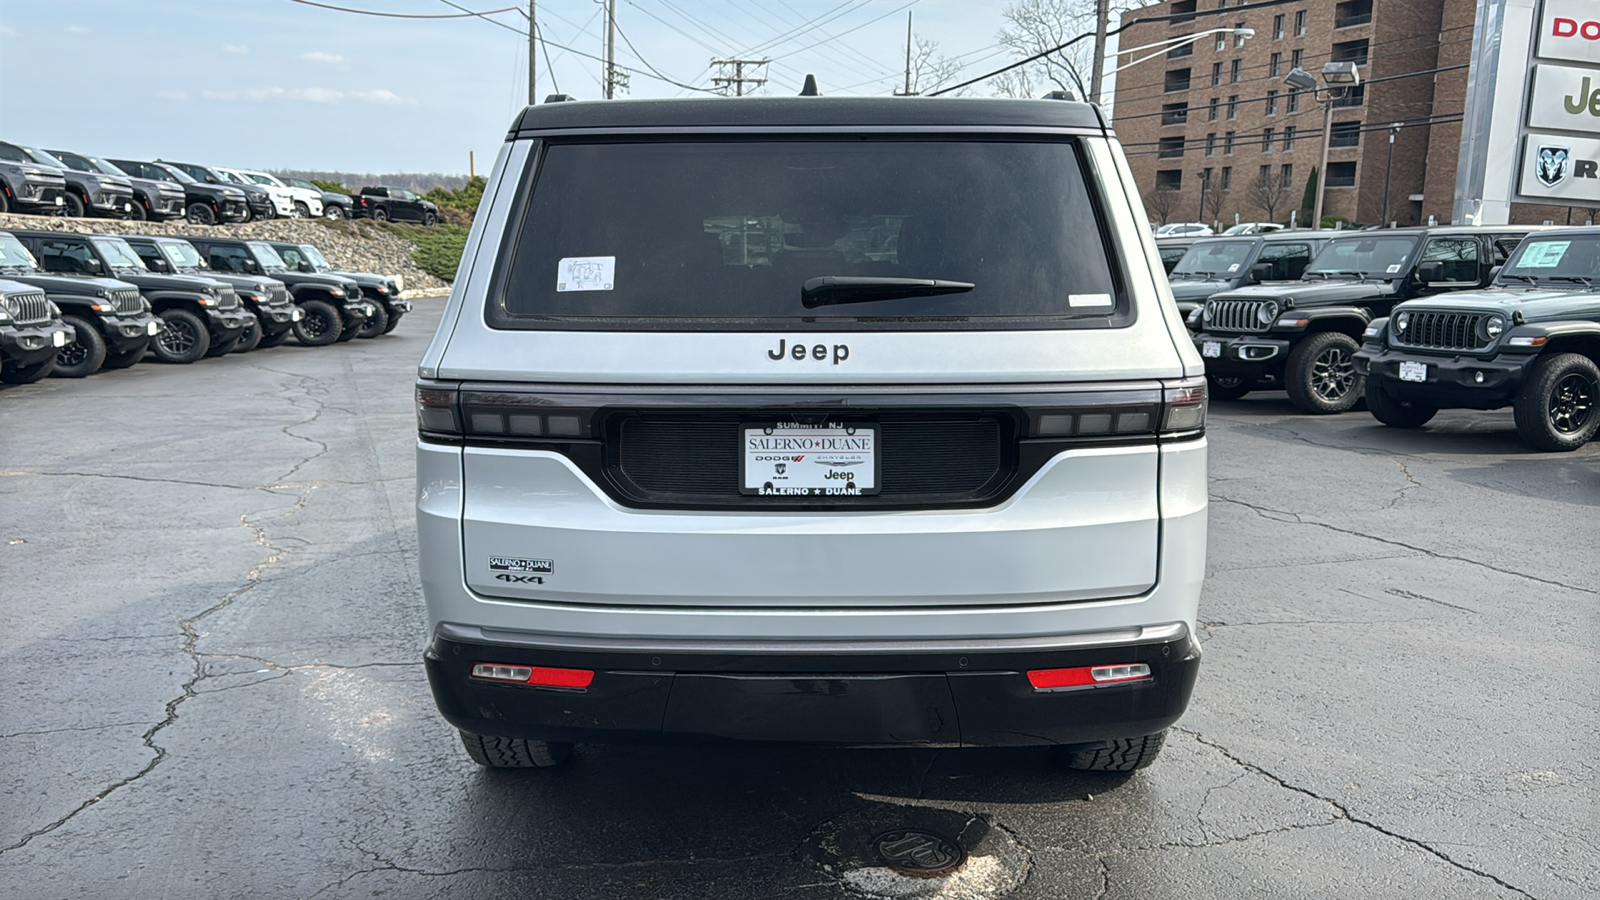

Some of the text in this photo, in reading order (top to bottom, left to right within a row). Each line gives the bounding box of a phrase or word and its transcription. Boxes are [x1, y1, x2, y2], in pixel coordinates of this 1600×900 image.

[767, 338, 850, 365] Jeep
[828, 421, 844, 429] NJ
[749, 438, 871, 450] SALERNO DUANE
[824, 469, 855, 481] Jeep
[758, 488, 862, 496] SALERNO DUANE
[490, 558, 521, 567] SALERNO
[526, 560, 551, 569] DUANE
